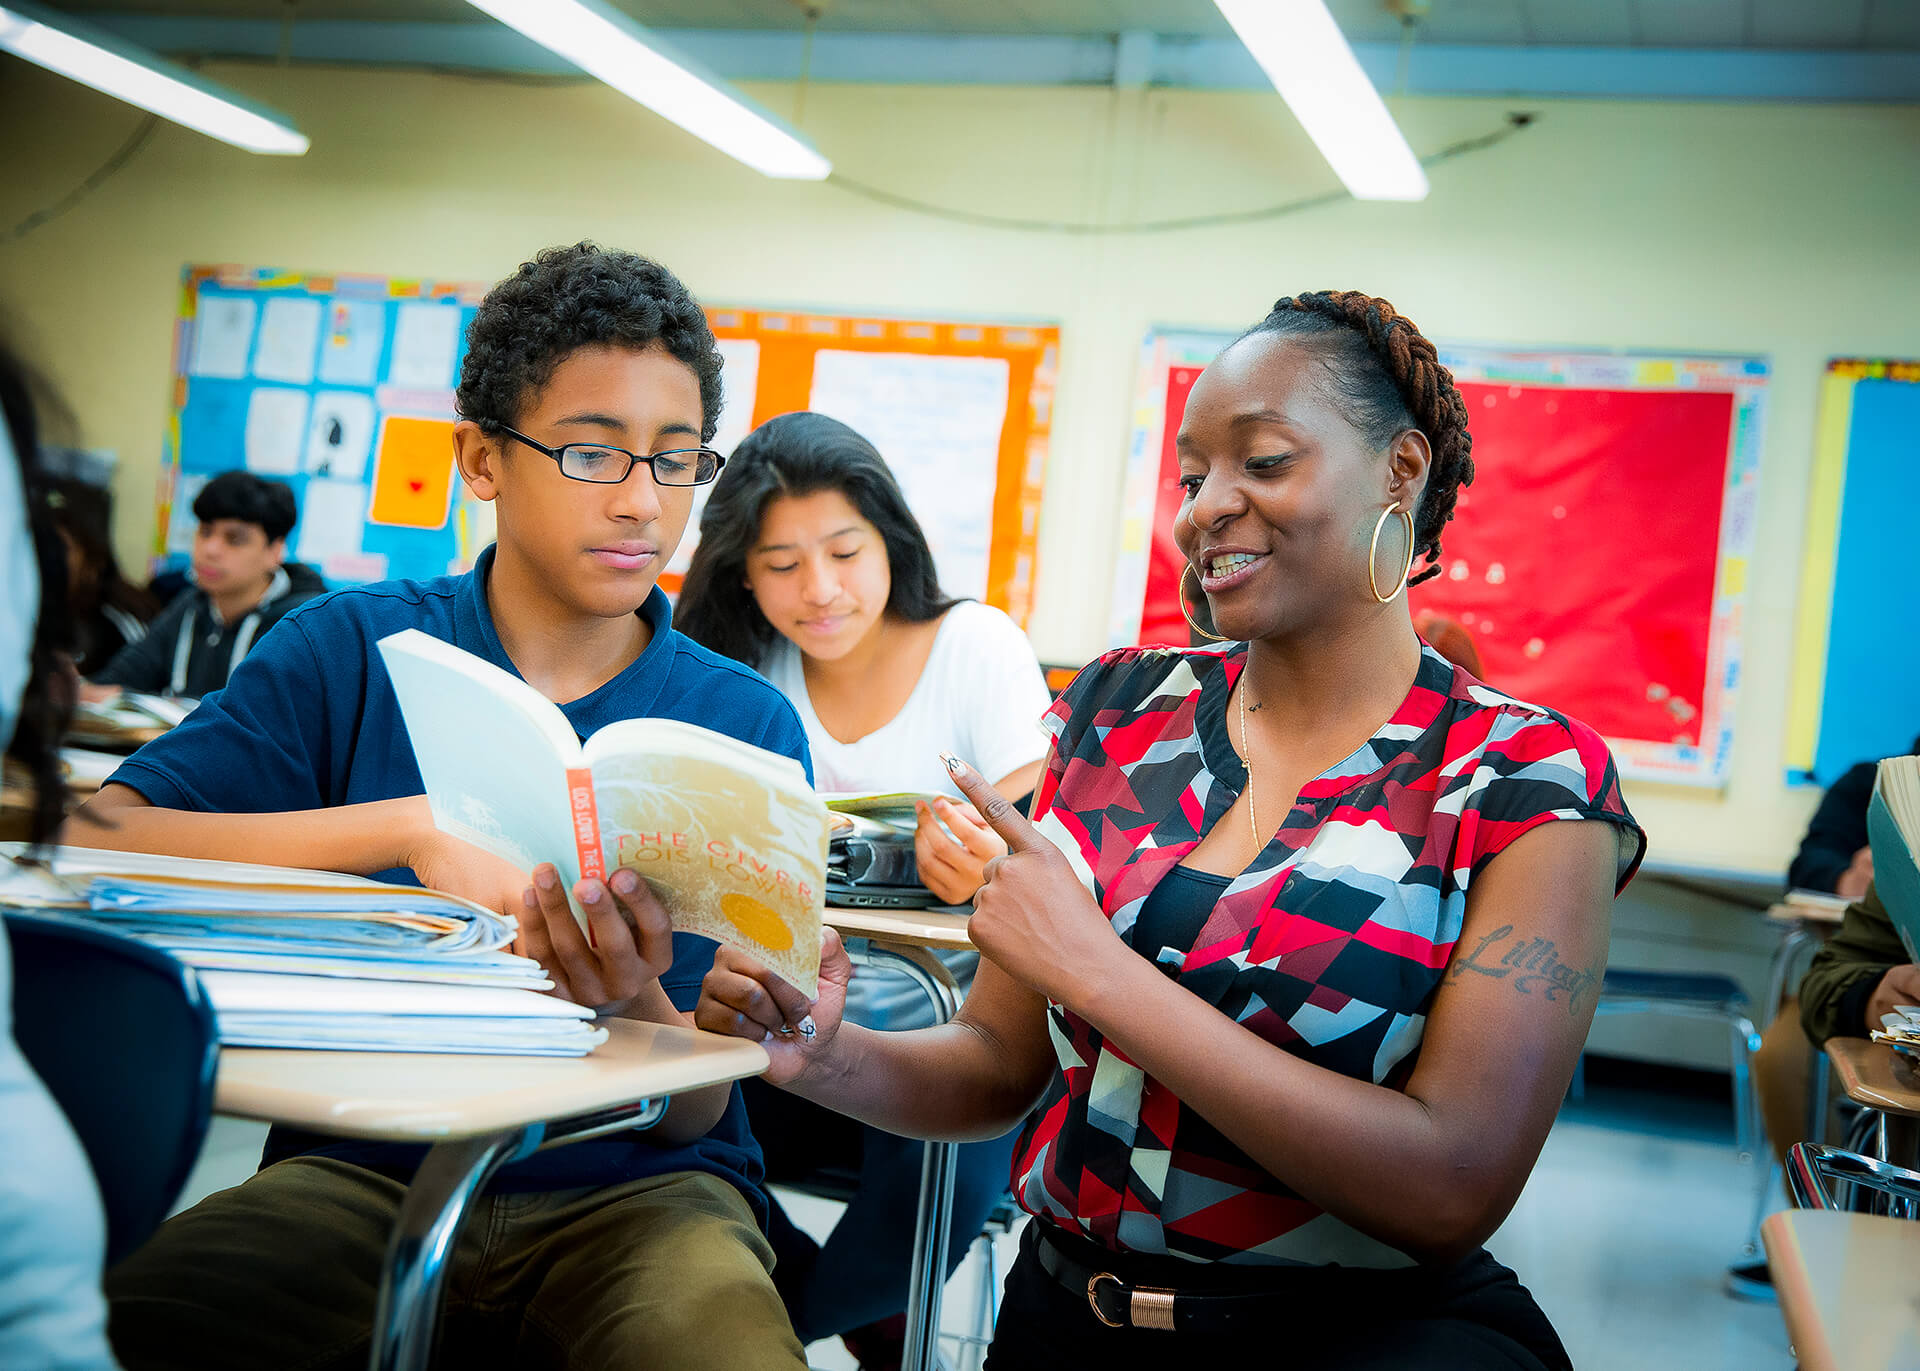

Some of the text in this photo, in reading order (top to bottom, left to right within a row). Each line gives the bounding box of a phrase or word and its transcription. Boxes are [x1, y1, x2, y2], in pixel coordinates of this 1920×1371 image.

[572, 787, 591, 810] LOIS
[583, 848, 599, 868] THE
[614, 832, 814, 903] THE GIVER
[618, 847, 813, 916] LOIS LOWRY
